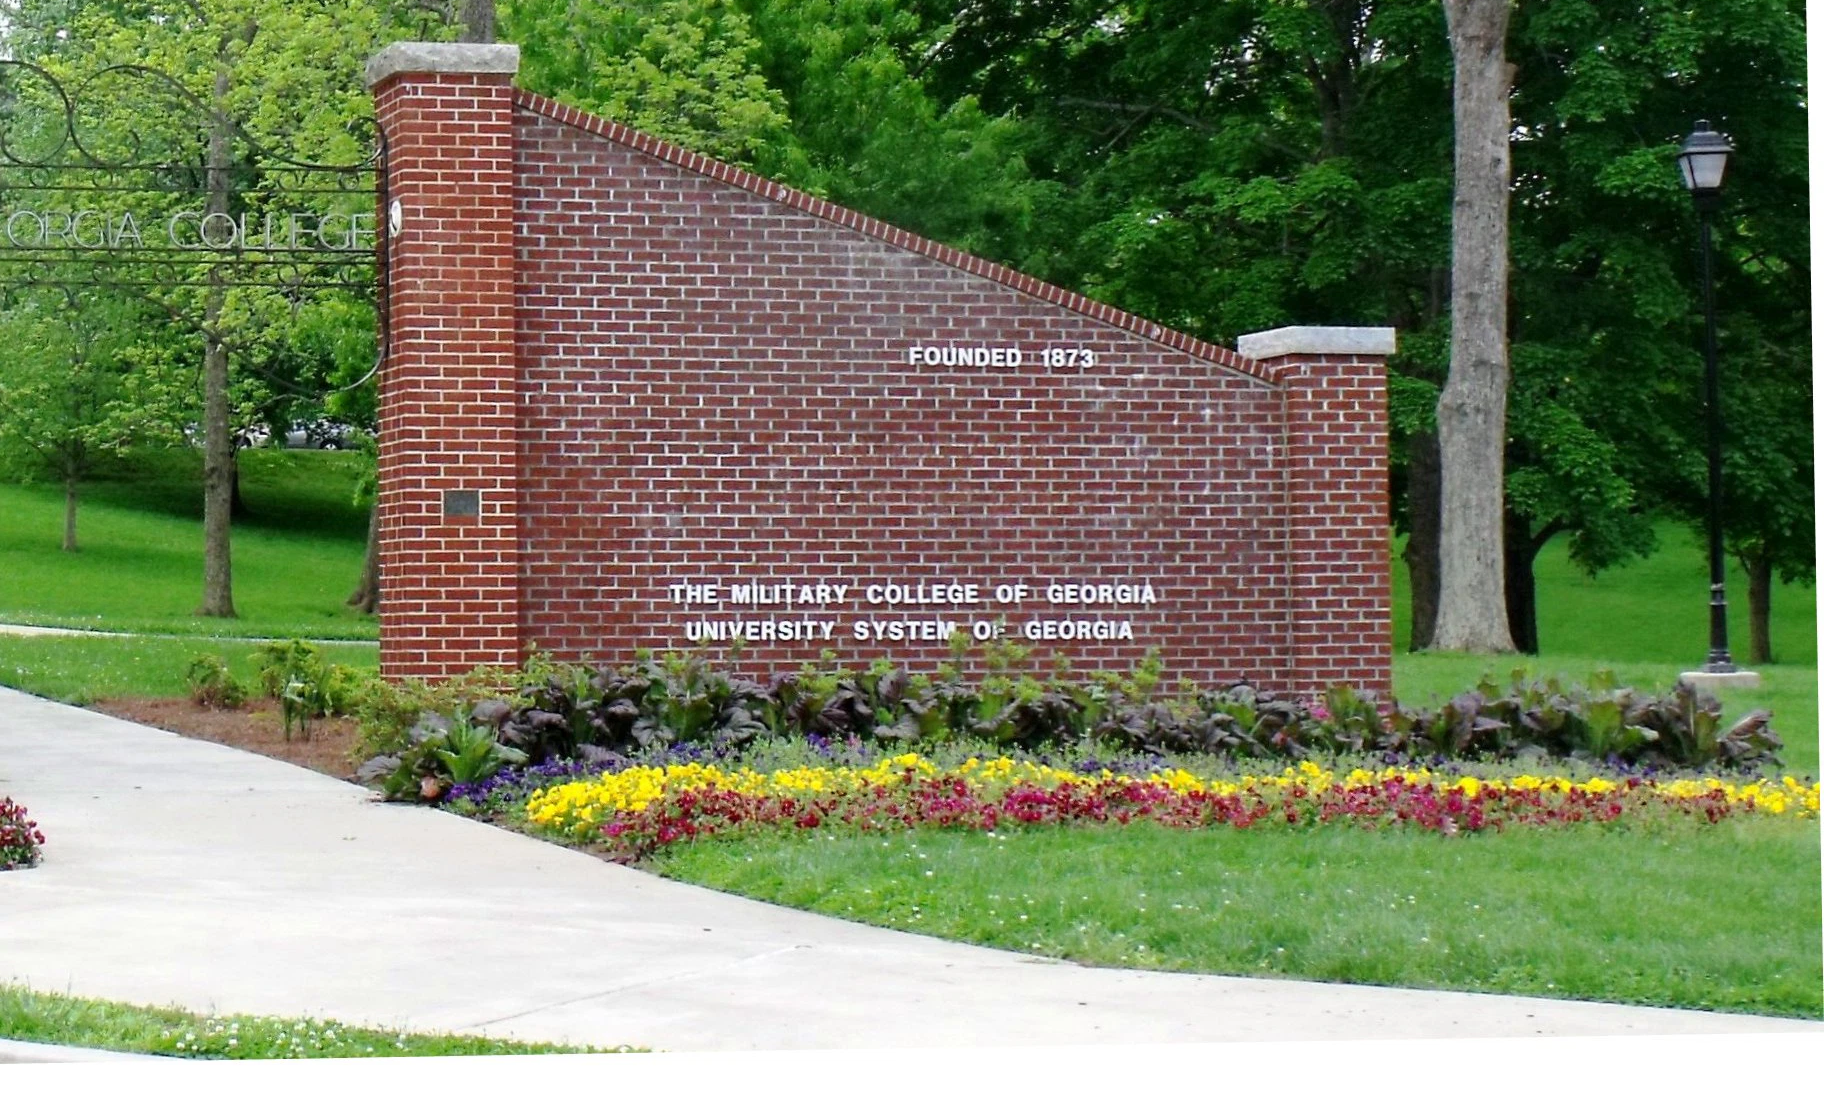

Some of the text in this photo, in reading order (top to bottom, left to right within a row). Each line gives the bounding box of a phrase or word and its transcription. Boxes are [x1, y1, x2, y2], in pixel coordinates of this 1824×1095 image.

[169, 212, 376, 250] COLLEGE
[909, 347, 1095, 368] FOUNDED 1873
[670, 584, 1157, 604] THE MILITARY COLLEGE OF GEORGIA
[686, 621, 835, 641] UNIVERSITY
[854, 620, 956, 641] SYSTEM
[1025, 620, 1133, 641] GEORGIA
